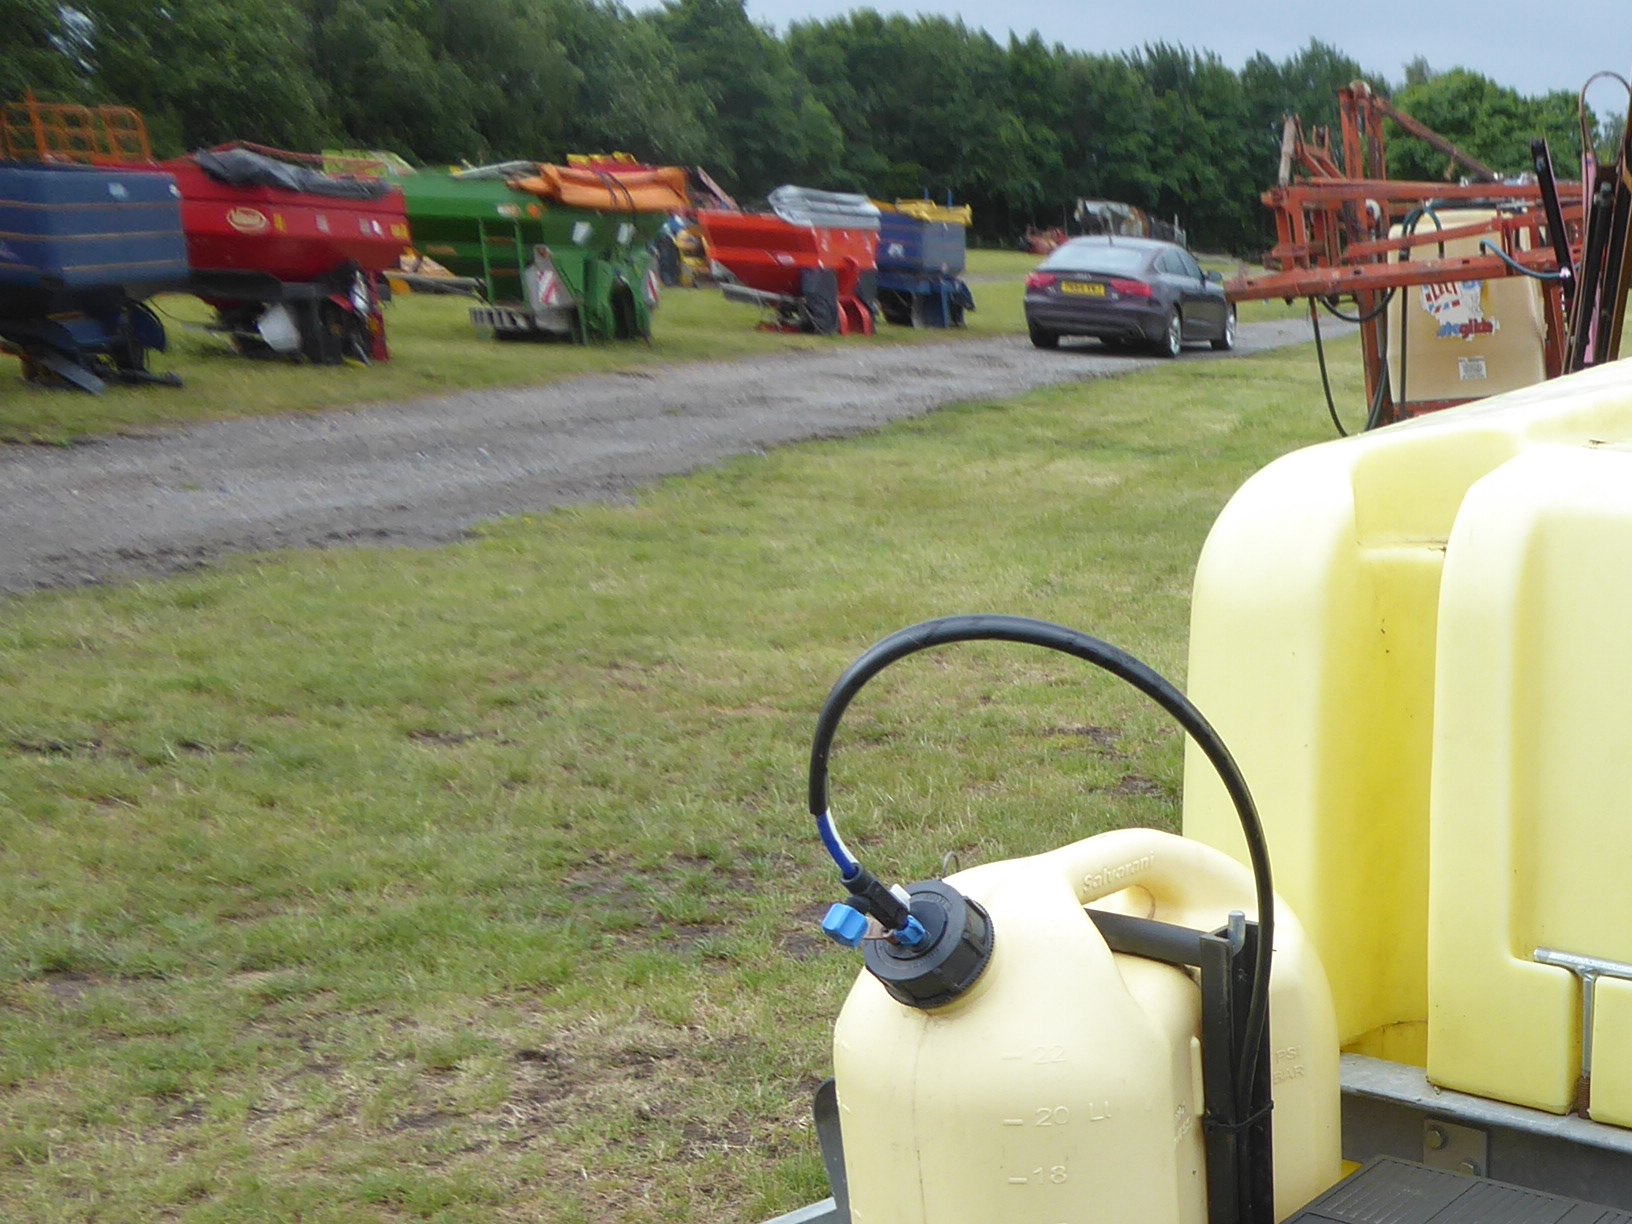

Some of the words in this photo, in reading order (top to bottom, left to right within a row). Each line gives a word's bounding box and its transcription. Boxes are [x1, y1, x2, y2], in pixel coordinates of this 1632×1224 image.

[1032, 1043, 1067, 1065] 22
[1034, 1105, 1070, 1128] 20
[1032, 1165, 1068, 1186] 18
